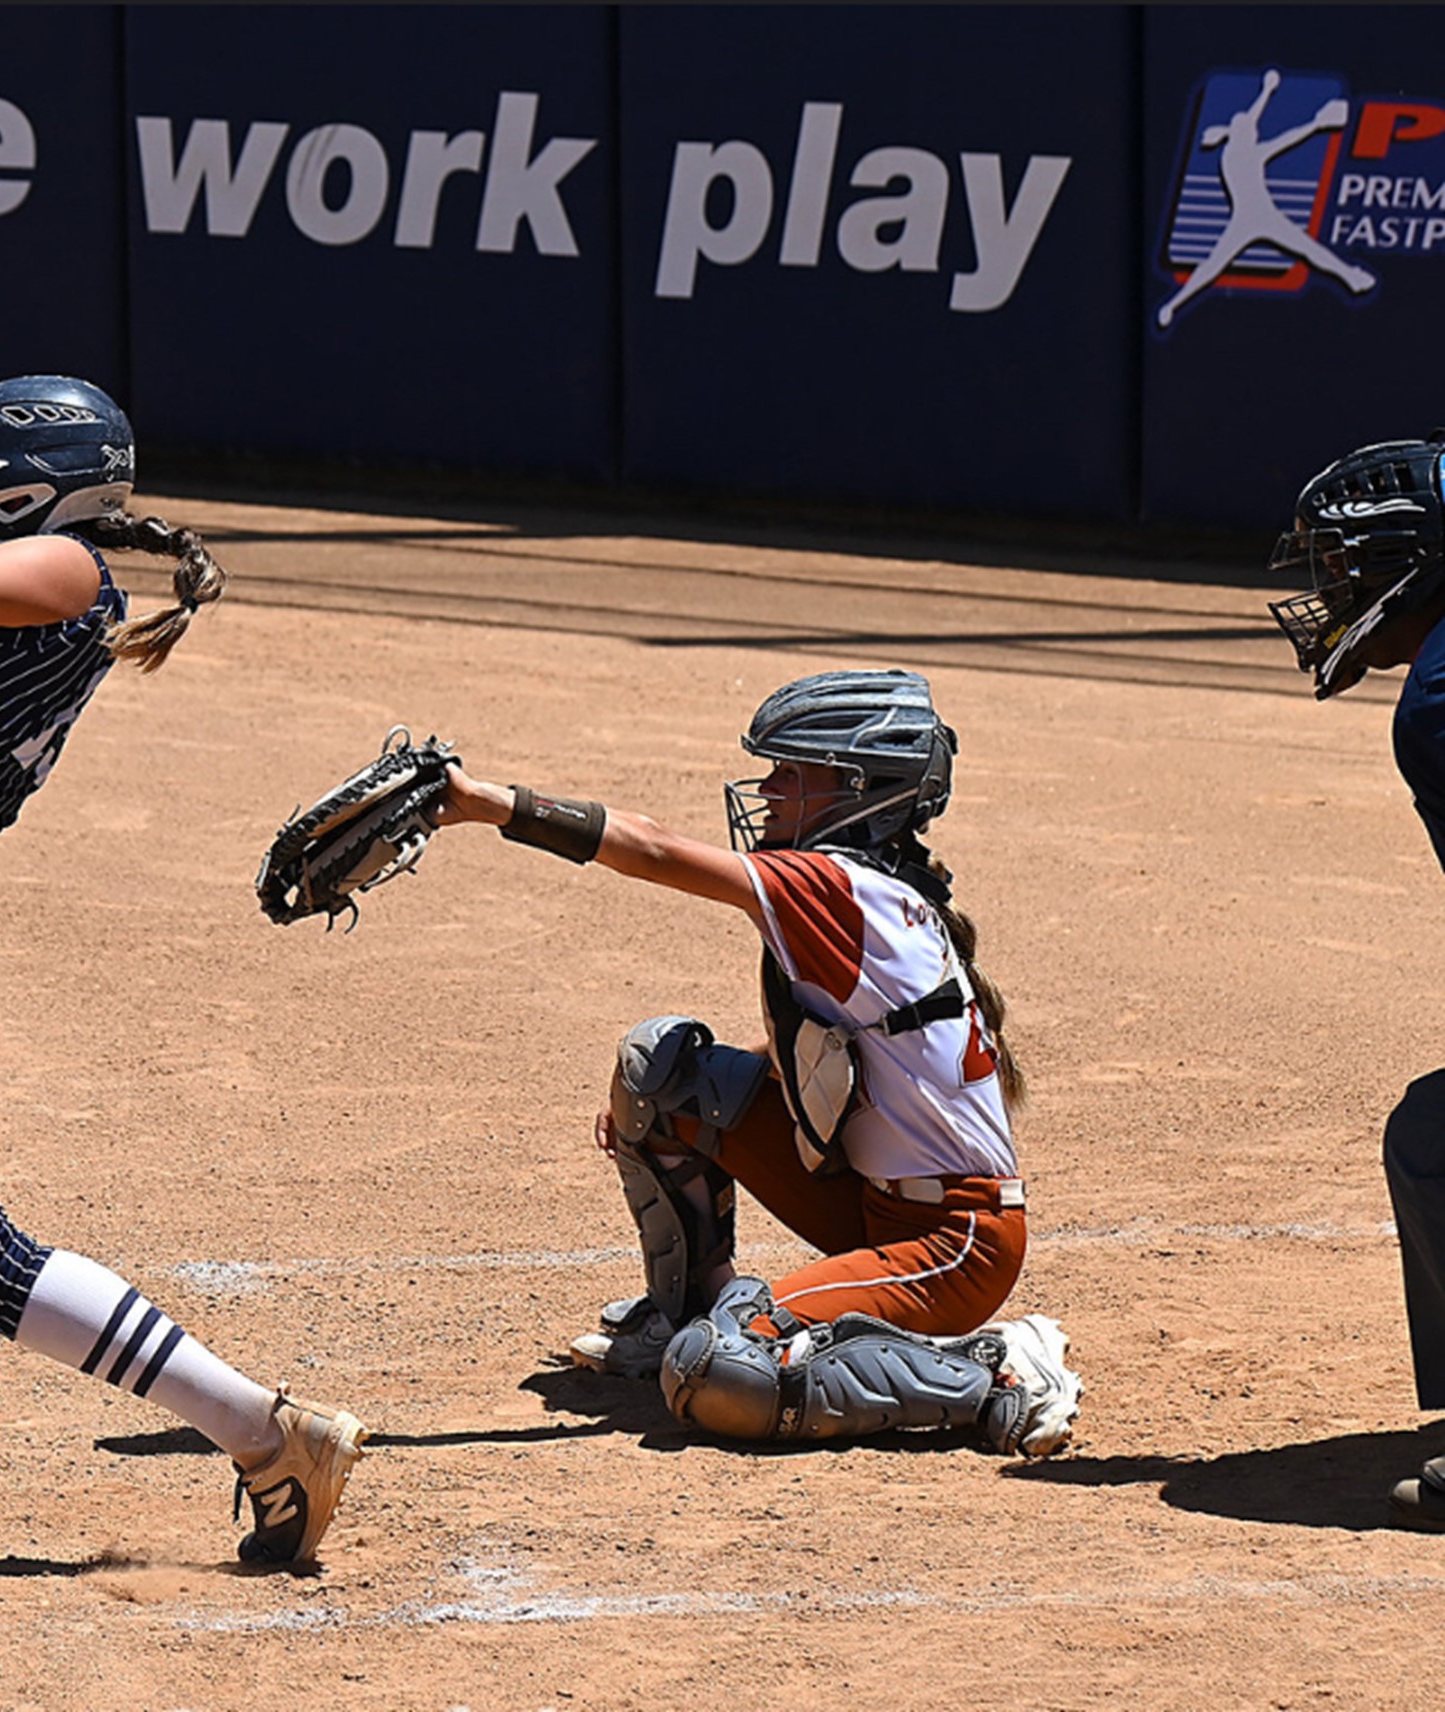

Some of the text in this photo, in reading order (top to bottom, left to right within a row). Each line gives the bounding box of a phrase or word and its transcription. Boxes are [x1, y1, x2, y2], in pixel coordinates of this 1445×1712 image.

[136, 91, 597, 256] work
[655, 102, 1072, 312] play
[1337, 174, 1445, 210] PREM
[1331, 215, 1445, 249] FASTP
